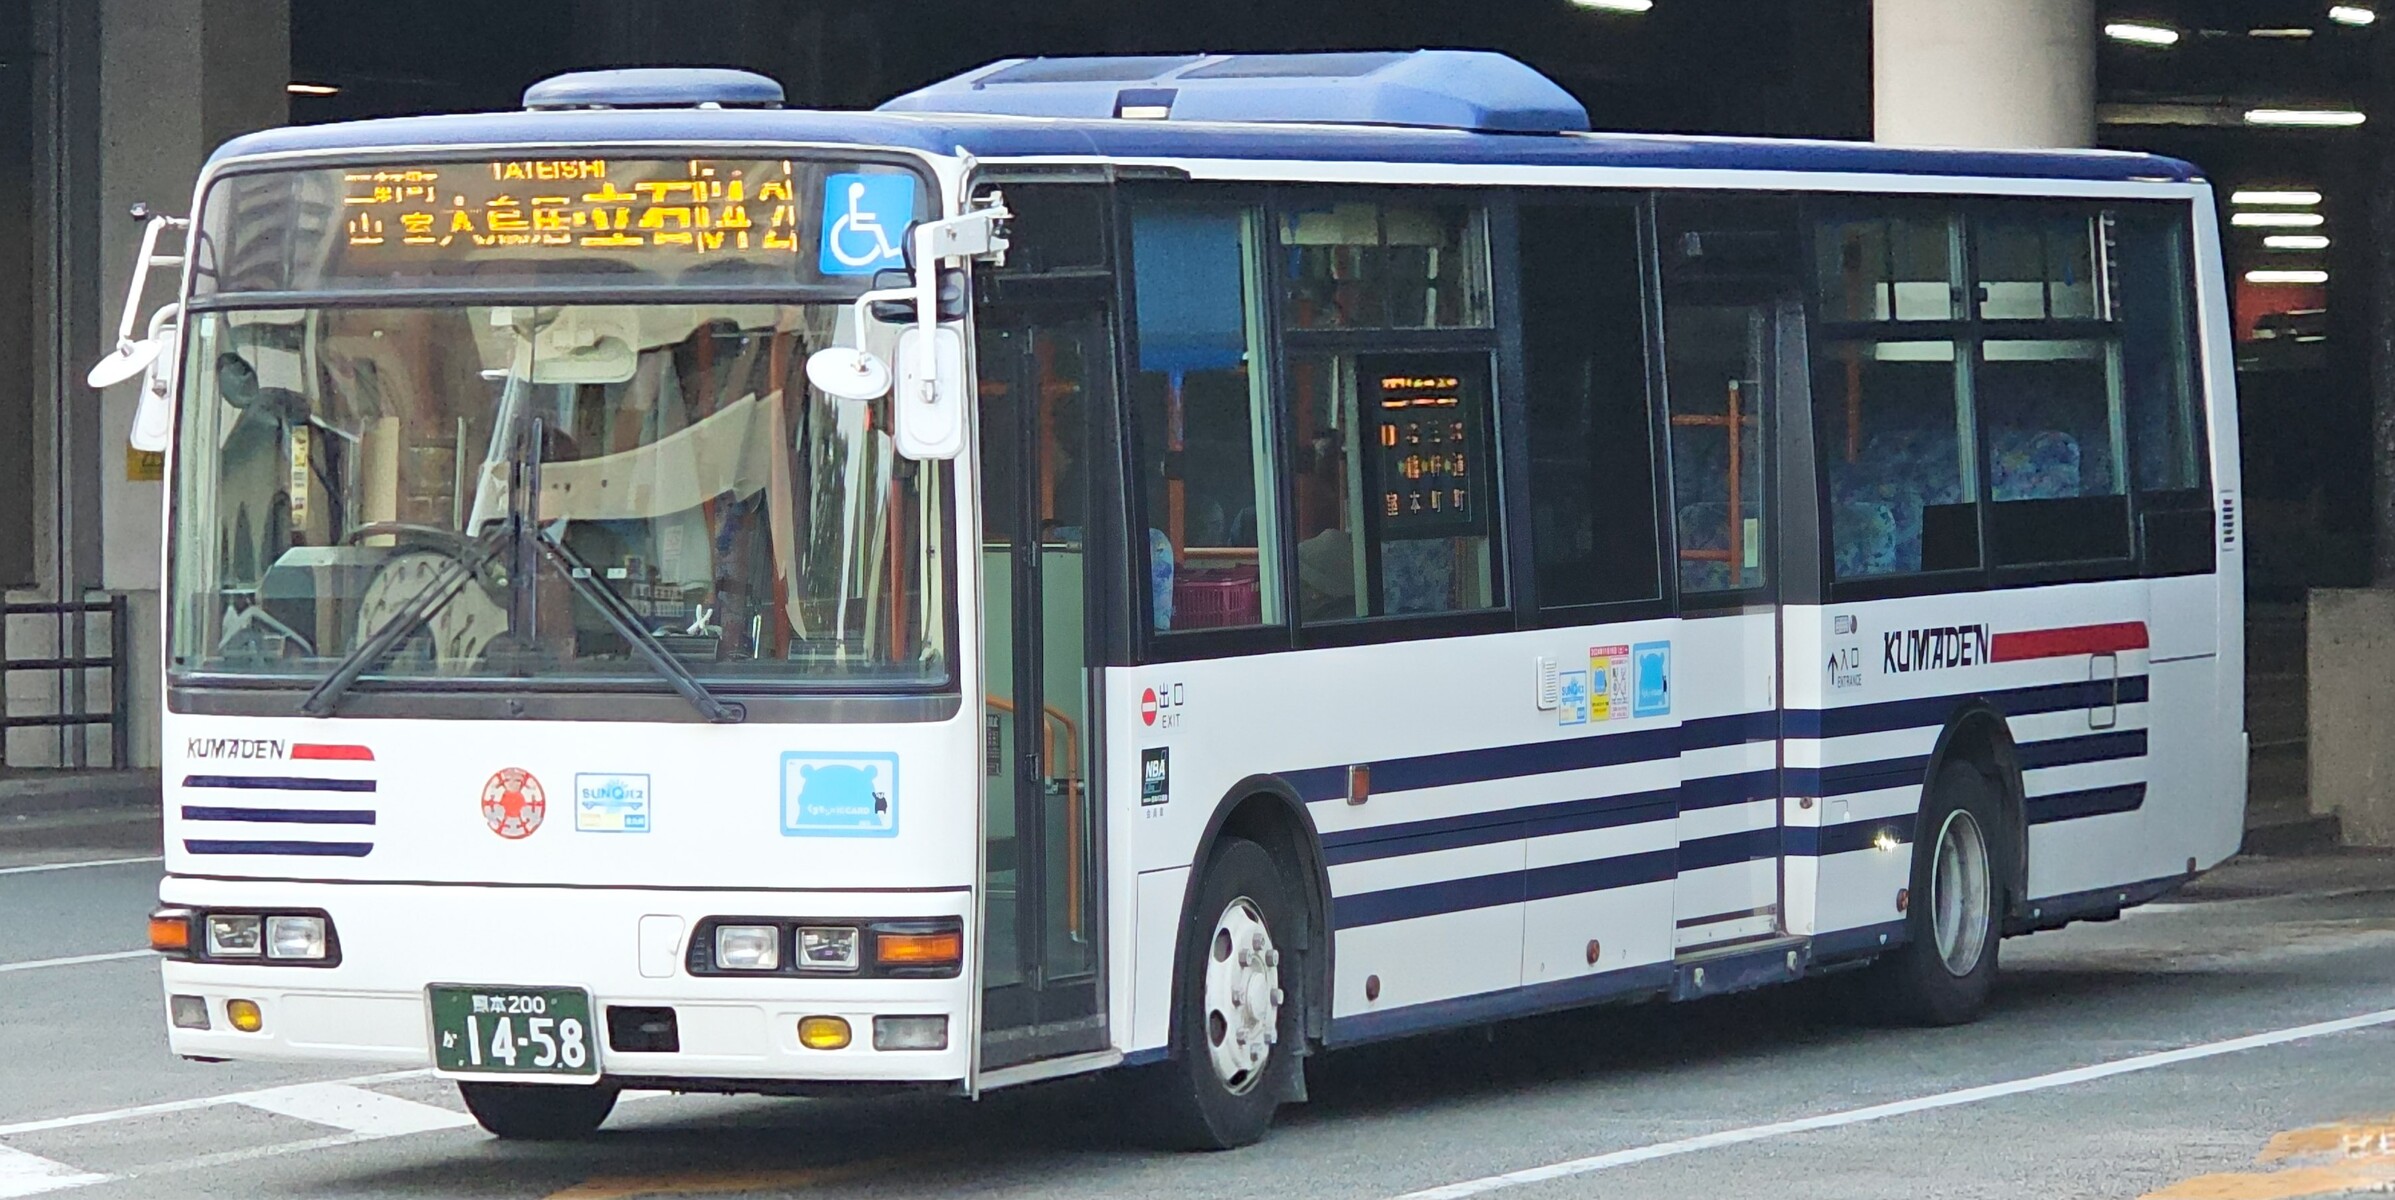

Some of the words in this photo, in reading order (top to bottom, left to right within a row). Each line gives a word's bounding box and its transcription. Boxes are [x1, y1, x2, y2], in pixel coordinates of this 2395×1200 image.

[1840, 647, 1859, 671] 入口
[1884, 623, 1989, 674] KUMADEN
[1159, 682, 1184, 708] 出口
[1162, 713, 1181, 728] EXIT
[187, 737, 285, 759] KUMADEN
[1145, 759, 1166, 778] NBA
[467, 1015, 586, 1068] 14-58
